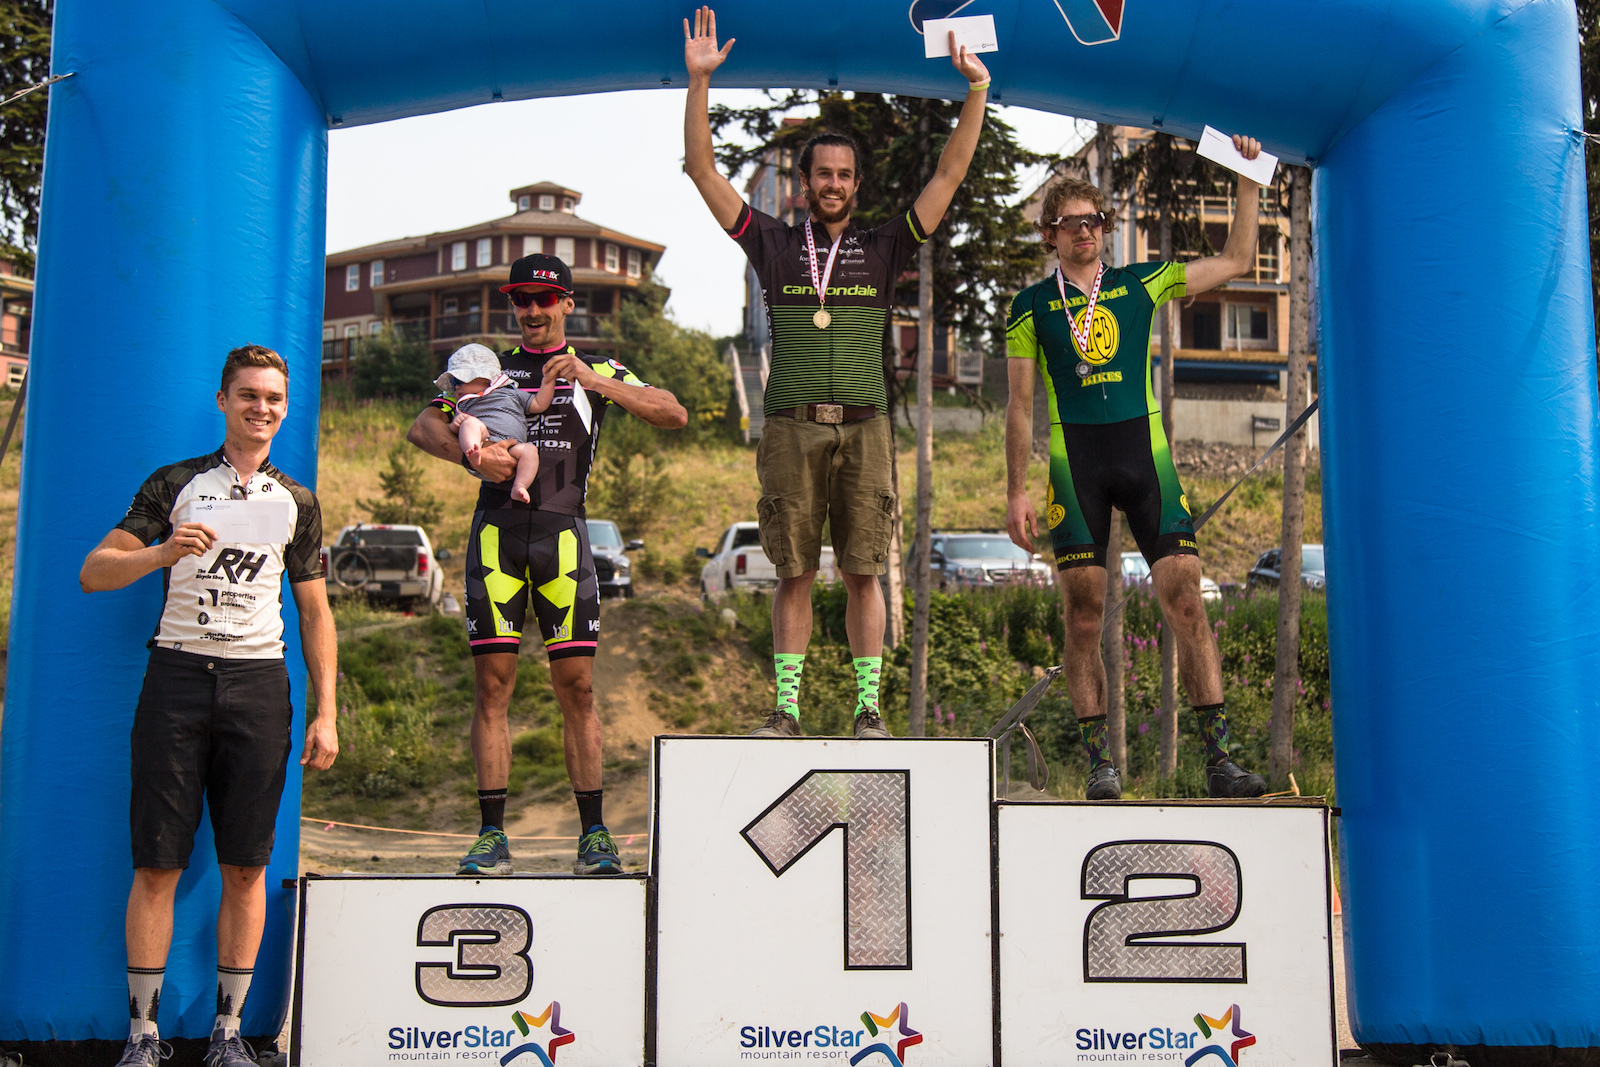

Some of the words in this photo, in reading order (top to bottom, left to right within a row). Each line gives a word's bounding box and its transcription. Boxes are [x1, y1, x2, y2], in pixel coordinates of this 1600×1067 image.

[783, 285, 877, 297] canondale
[1048, 285, 1128, 312] HARDORE
[1081, 371, 1122, 387] BIKES
[208, 548, 268, 584] RH
[221, 591, 256, 601] properties
[739, 769, 912, 971] 1
[1080, 840, 1248, 984] 2
[415, 903, 533, 1007] 3
[388, 1025, 516, 1049] SilverStar
[740, 1025, 864, 1048] SilverStar
[1075, 1027, 1198, 1050] SilverStar
[388, 1050, 451, 1061] mountain
[456, 1050, 499, 1060] resort
[741, 1050, 802, 1059] mountain
[814, 1050, 849, 1059] resort
[1077, 1052, 1137, 1062] mountain
[1142, 1052, 1184, 1061] resort
